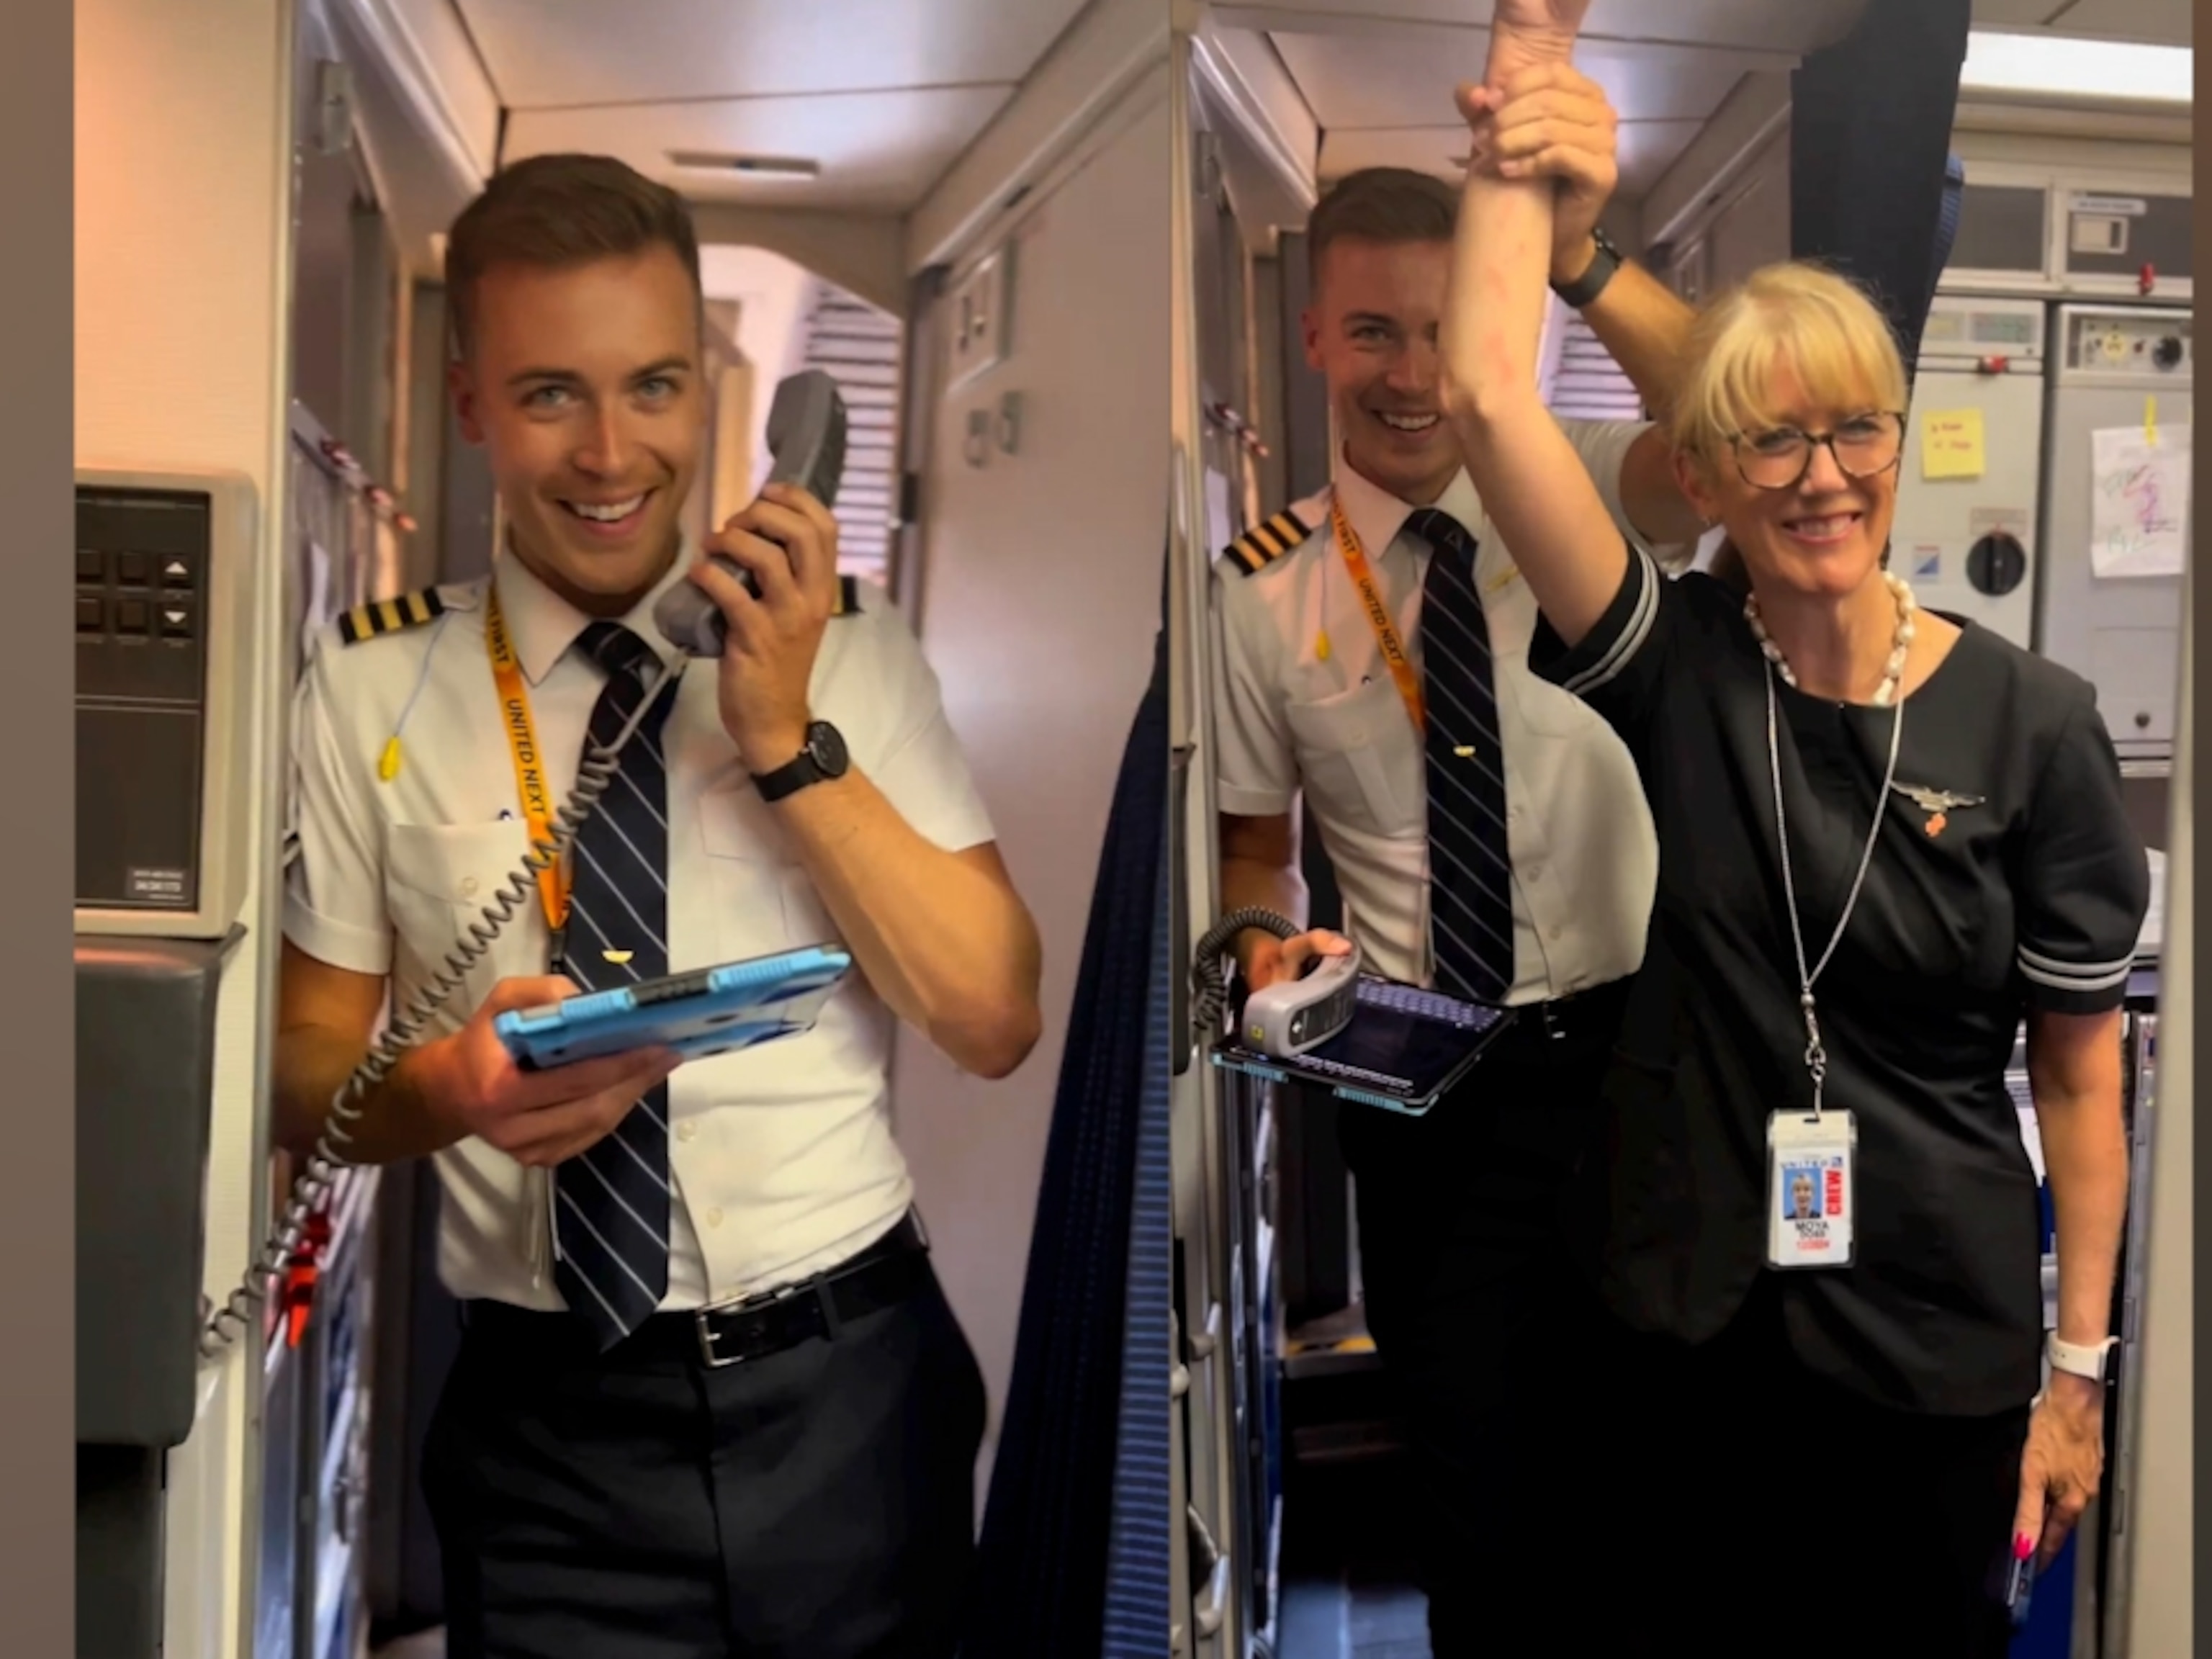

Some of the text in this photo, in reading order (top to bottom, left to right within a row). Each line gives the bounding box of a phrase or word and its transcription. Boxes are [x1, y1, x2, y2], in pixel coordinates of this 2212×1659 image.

[490, 619, 510, 662] FIRST
[1359, 577, 1404, 662] UNITED NEXT
[507, 698, 547, 815] UNITED NEXT
[1780, 1159, 1827, 1168] UNITED
[1826, 1169, 1842, 1215] CREW
